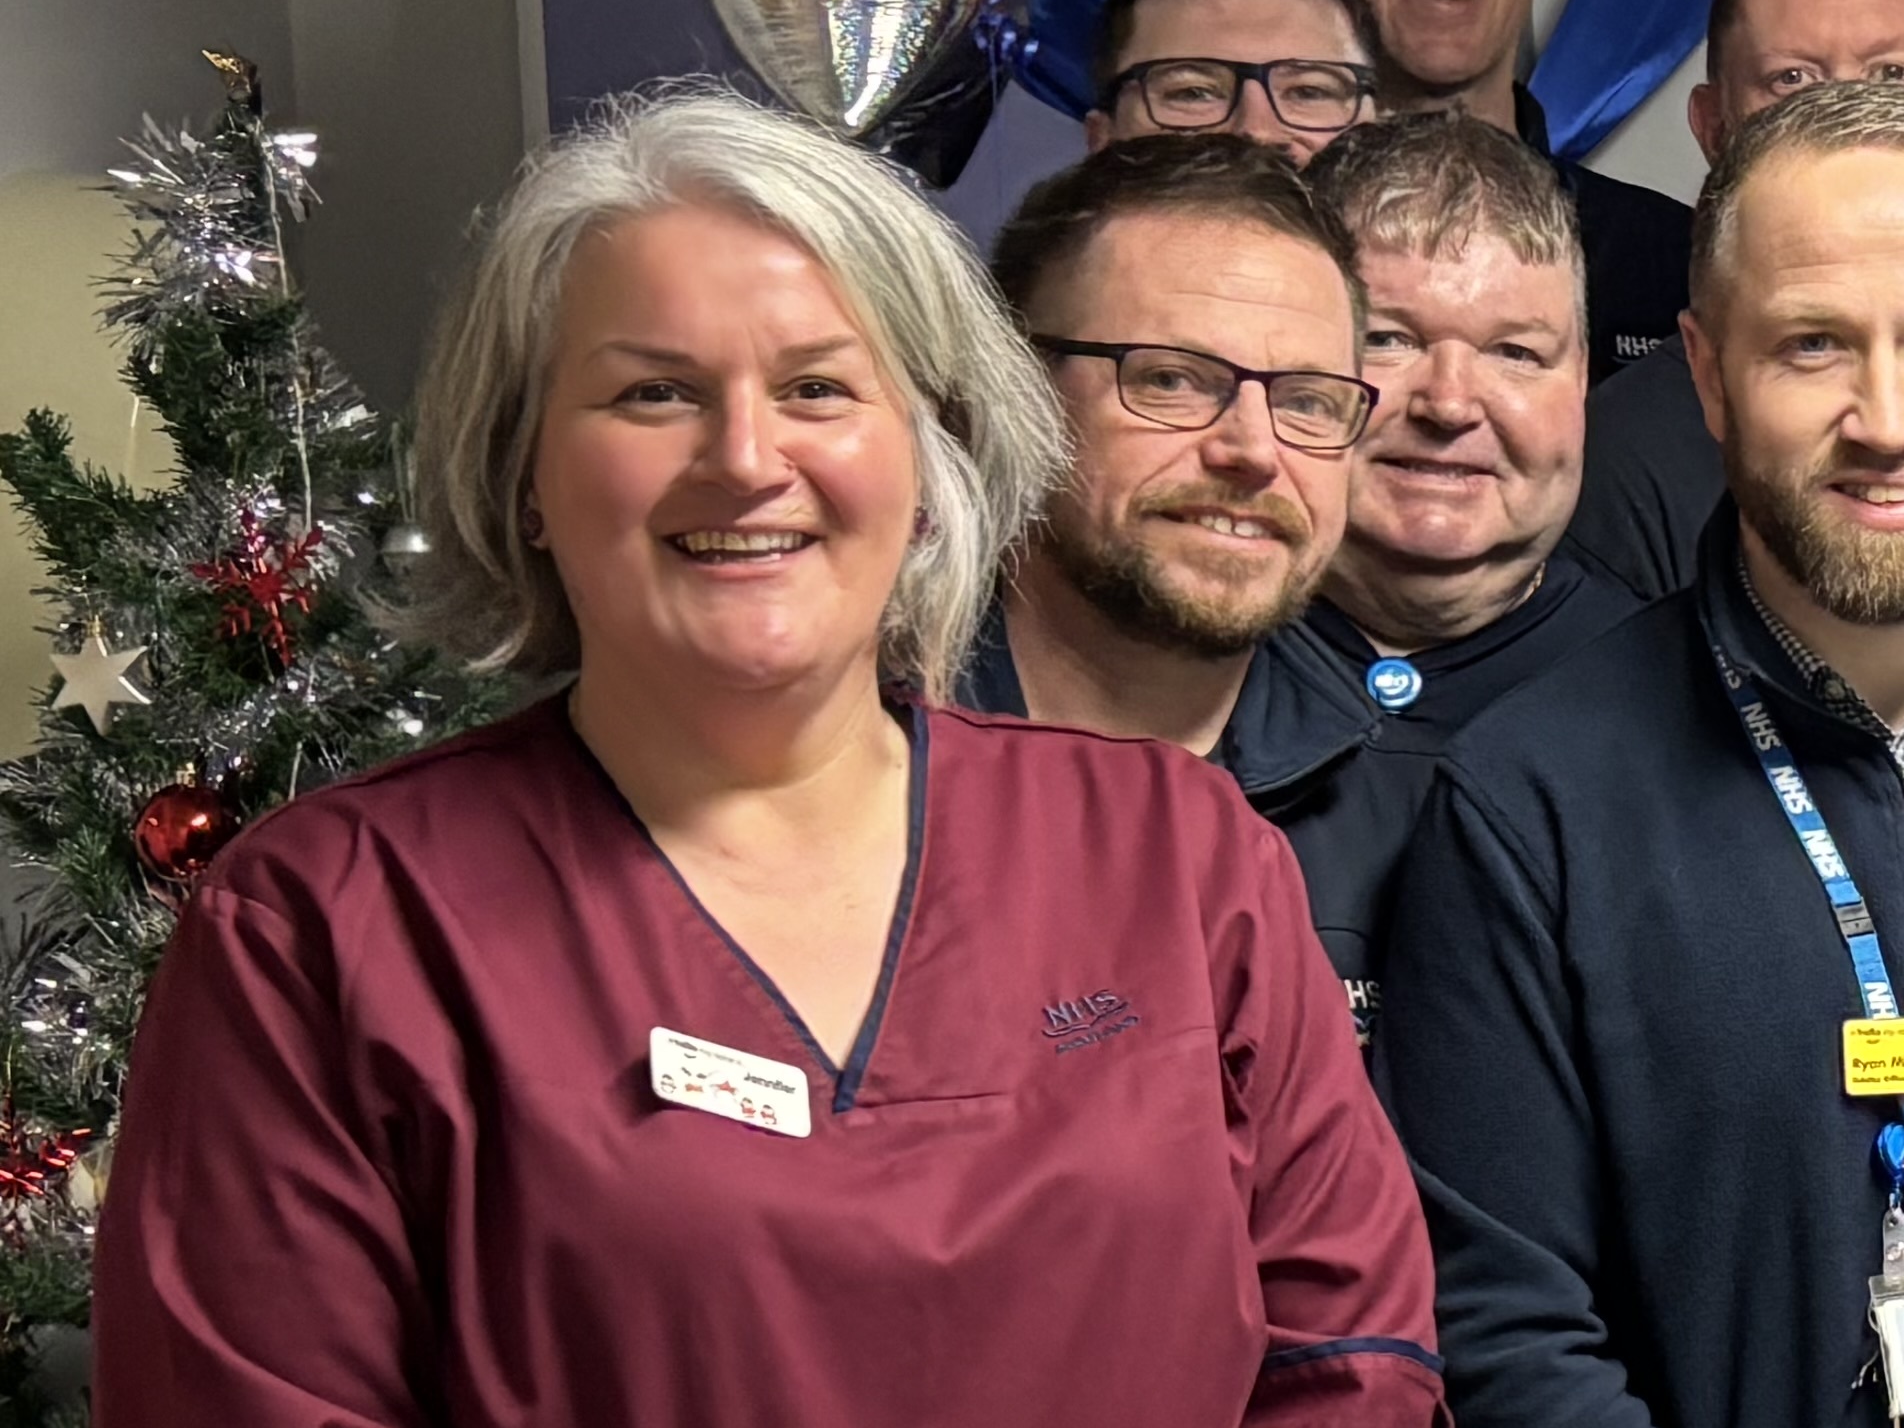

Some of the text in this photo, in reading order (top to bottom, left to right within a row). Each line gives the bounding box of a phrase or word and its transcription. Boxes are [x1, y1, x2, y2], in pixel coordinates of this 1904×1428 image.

[1741, 701, 1850, 882] NHS NHS NHS
[1042, 989, 1118, 1029] NHS
[1343, 978, 1384, 1009] HS
[1864, 982, 1900, 1019] NH
